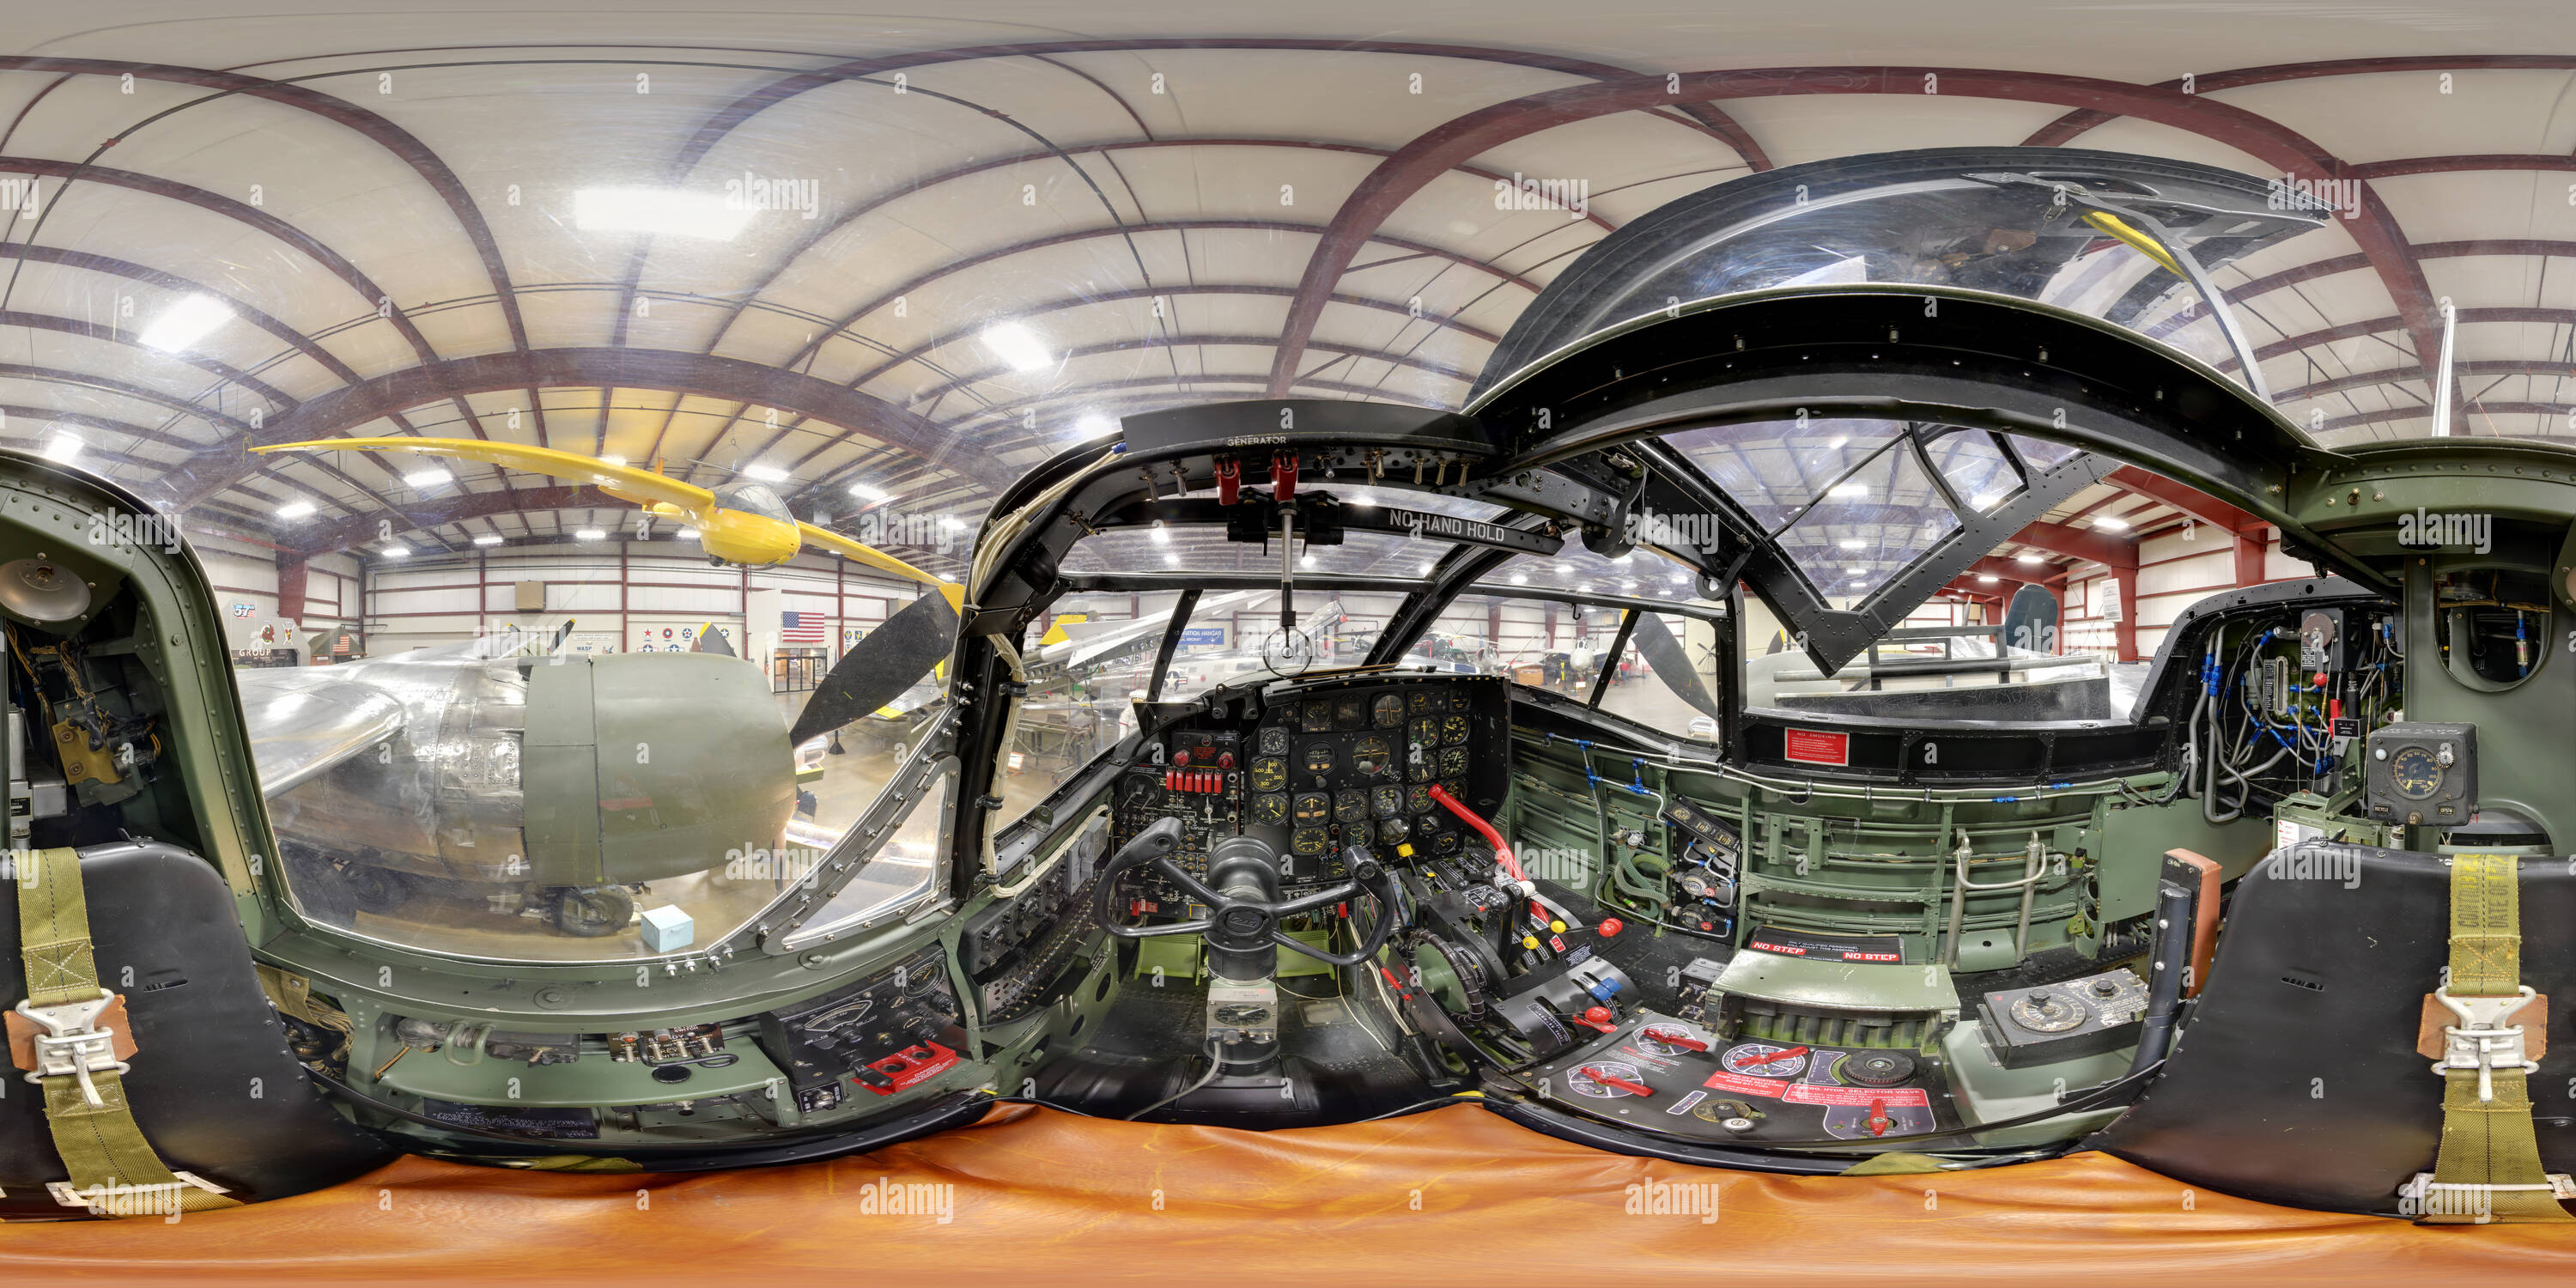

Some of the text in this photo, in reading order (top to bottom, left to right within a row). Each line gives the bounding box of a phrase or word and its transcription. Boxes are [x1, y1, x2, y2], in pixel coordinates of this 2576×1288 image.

[1227, 436, 1286, 447] GENERATOR
[1389, 509, 1504, 542] NO HAND HOLD
[239, 648, 272, 657] GROUP
[1772, 945, 1804, 955] STEP
[914, 1063, 939, 1077] DANGER
